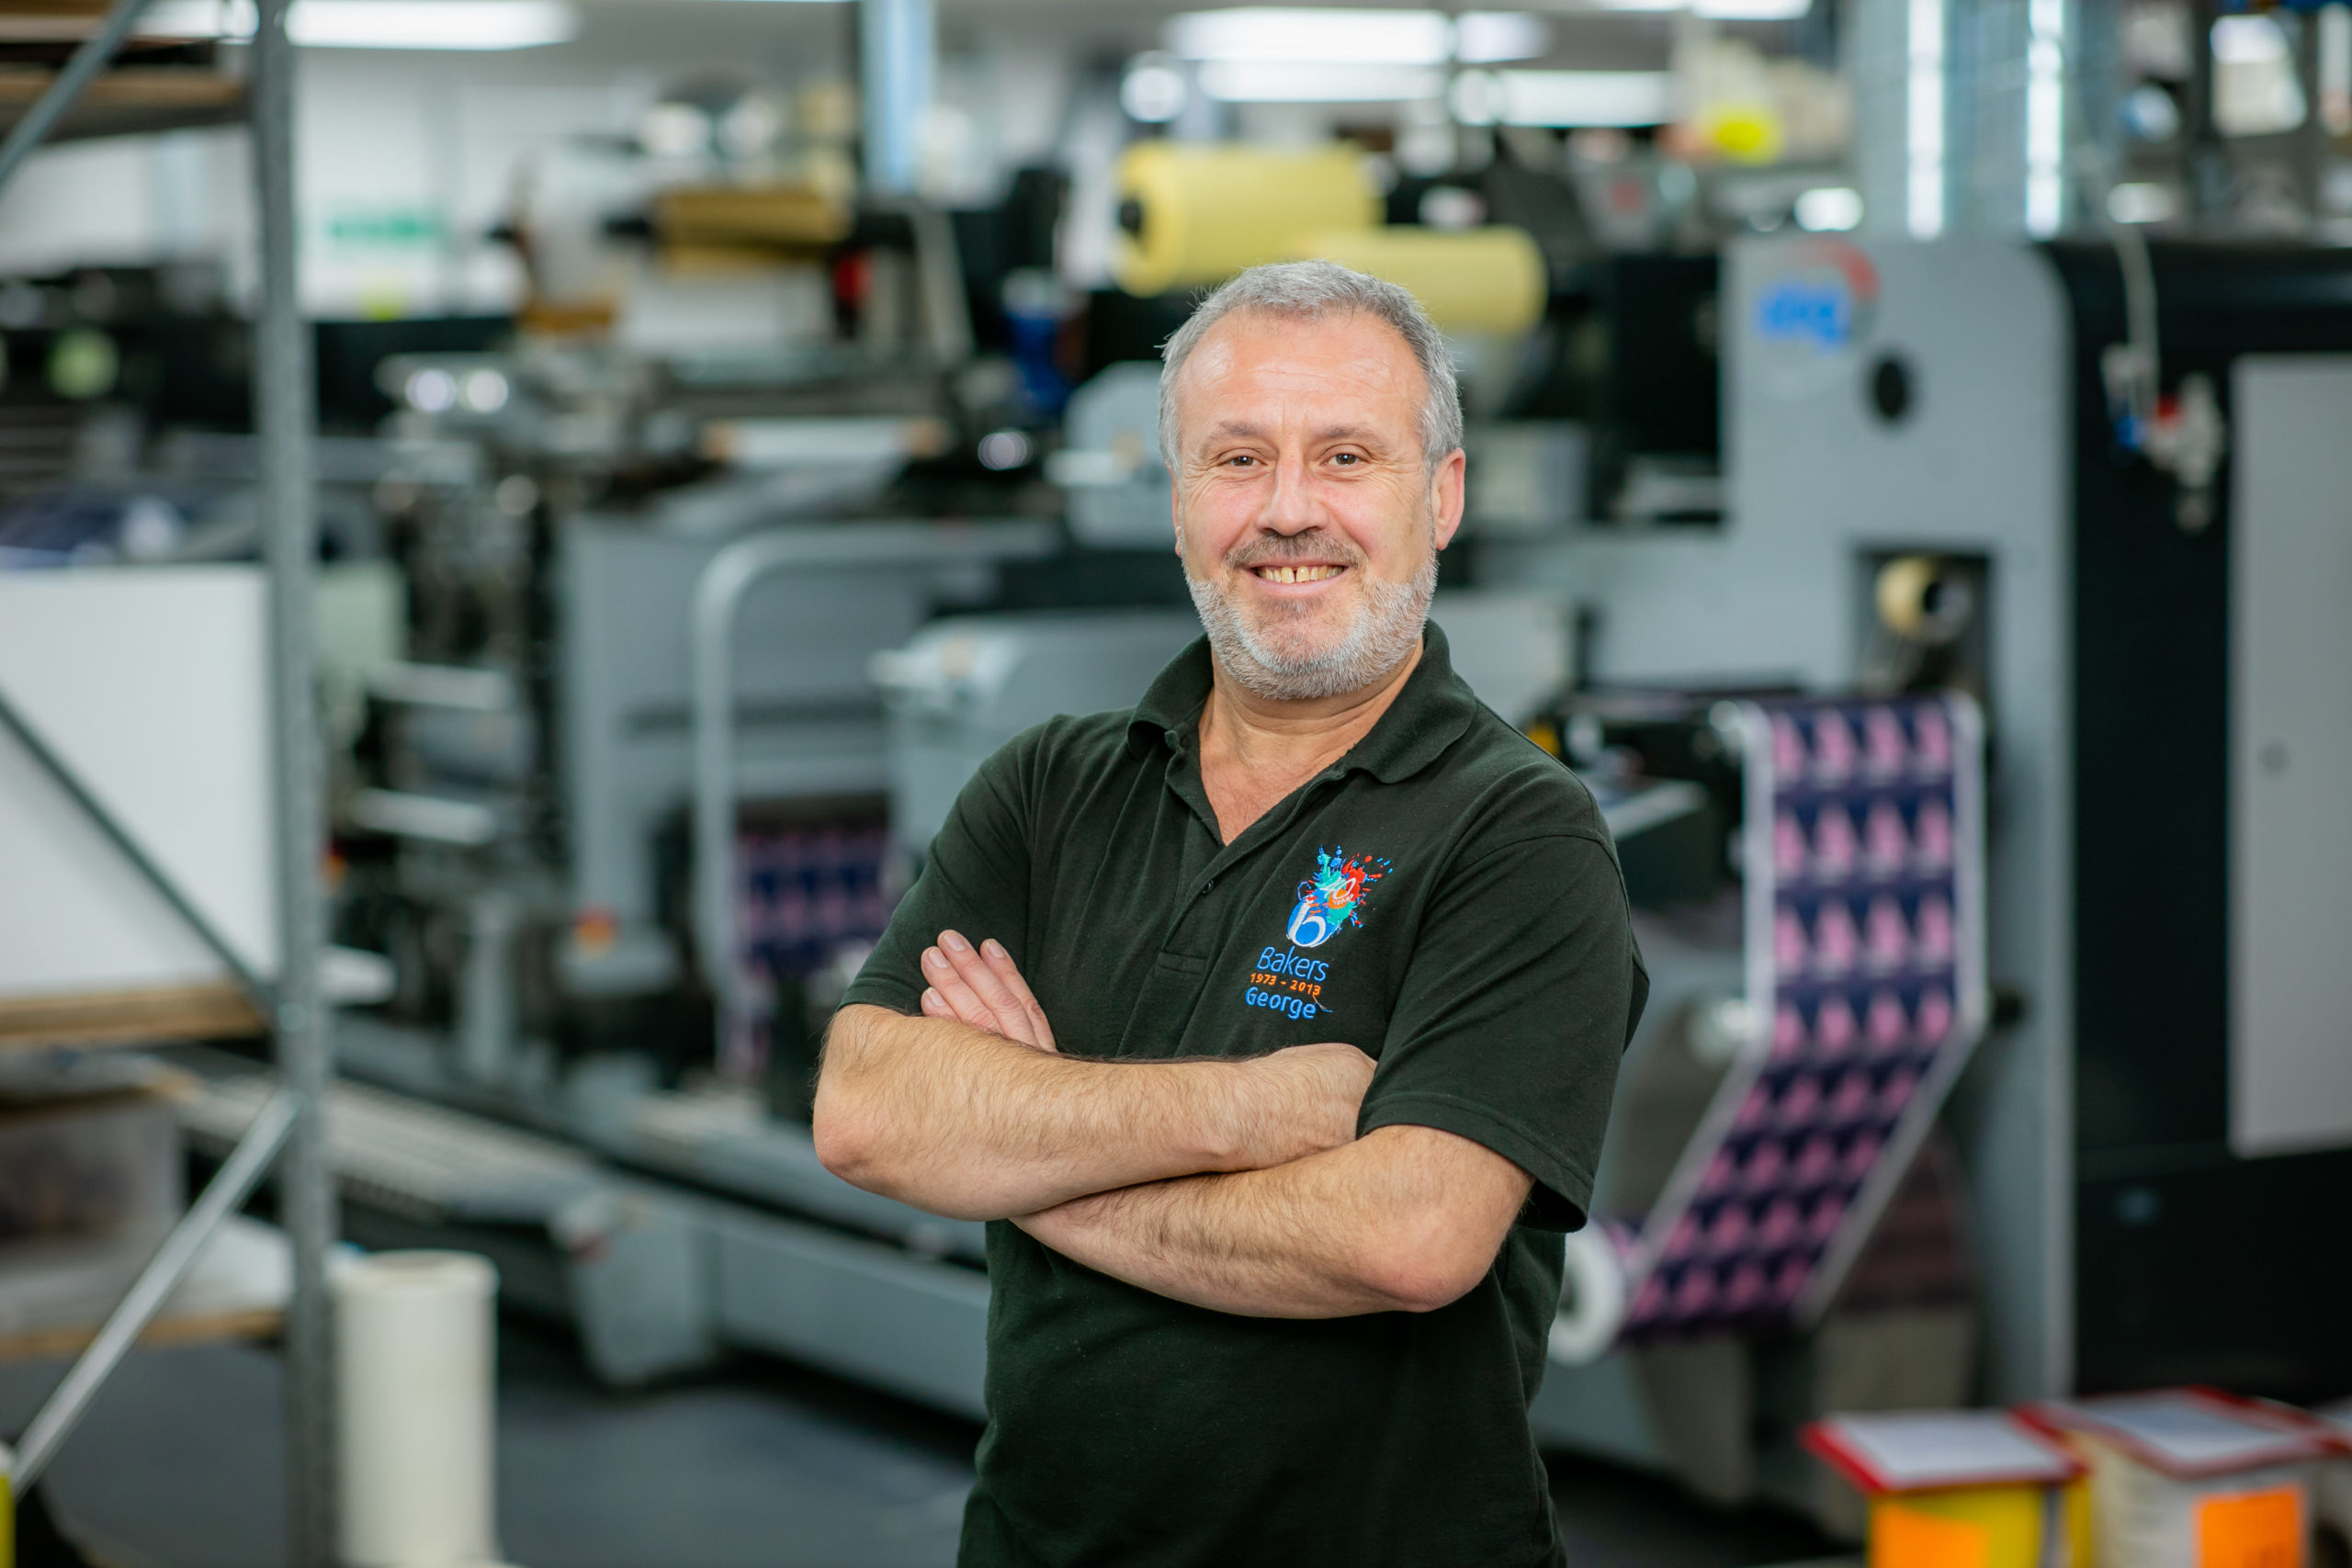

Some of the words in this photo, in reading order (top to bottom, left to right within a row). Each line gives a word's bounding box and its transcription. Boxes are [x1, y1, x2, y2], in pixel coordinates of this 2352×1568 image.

[1256, 945, 1329, 982] Bakers
[1250, 973, 1277, 986] 1973
[1289, 979, 1321, 997] 2013
[1245, 987, 1317, 1020] George
